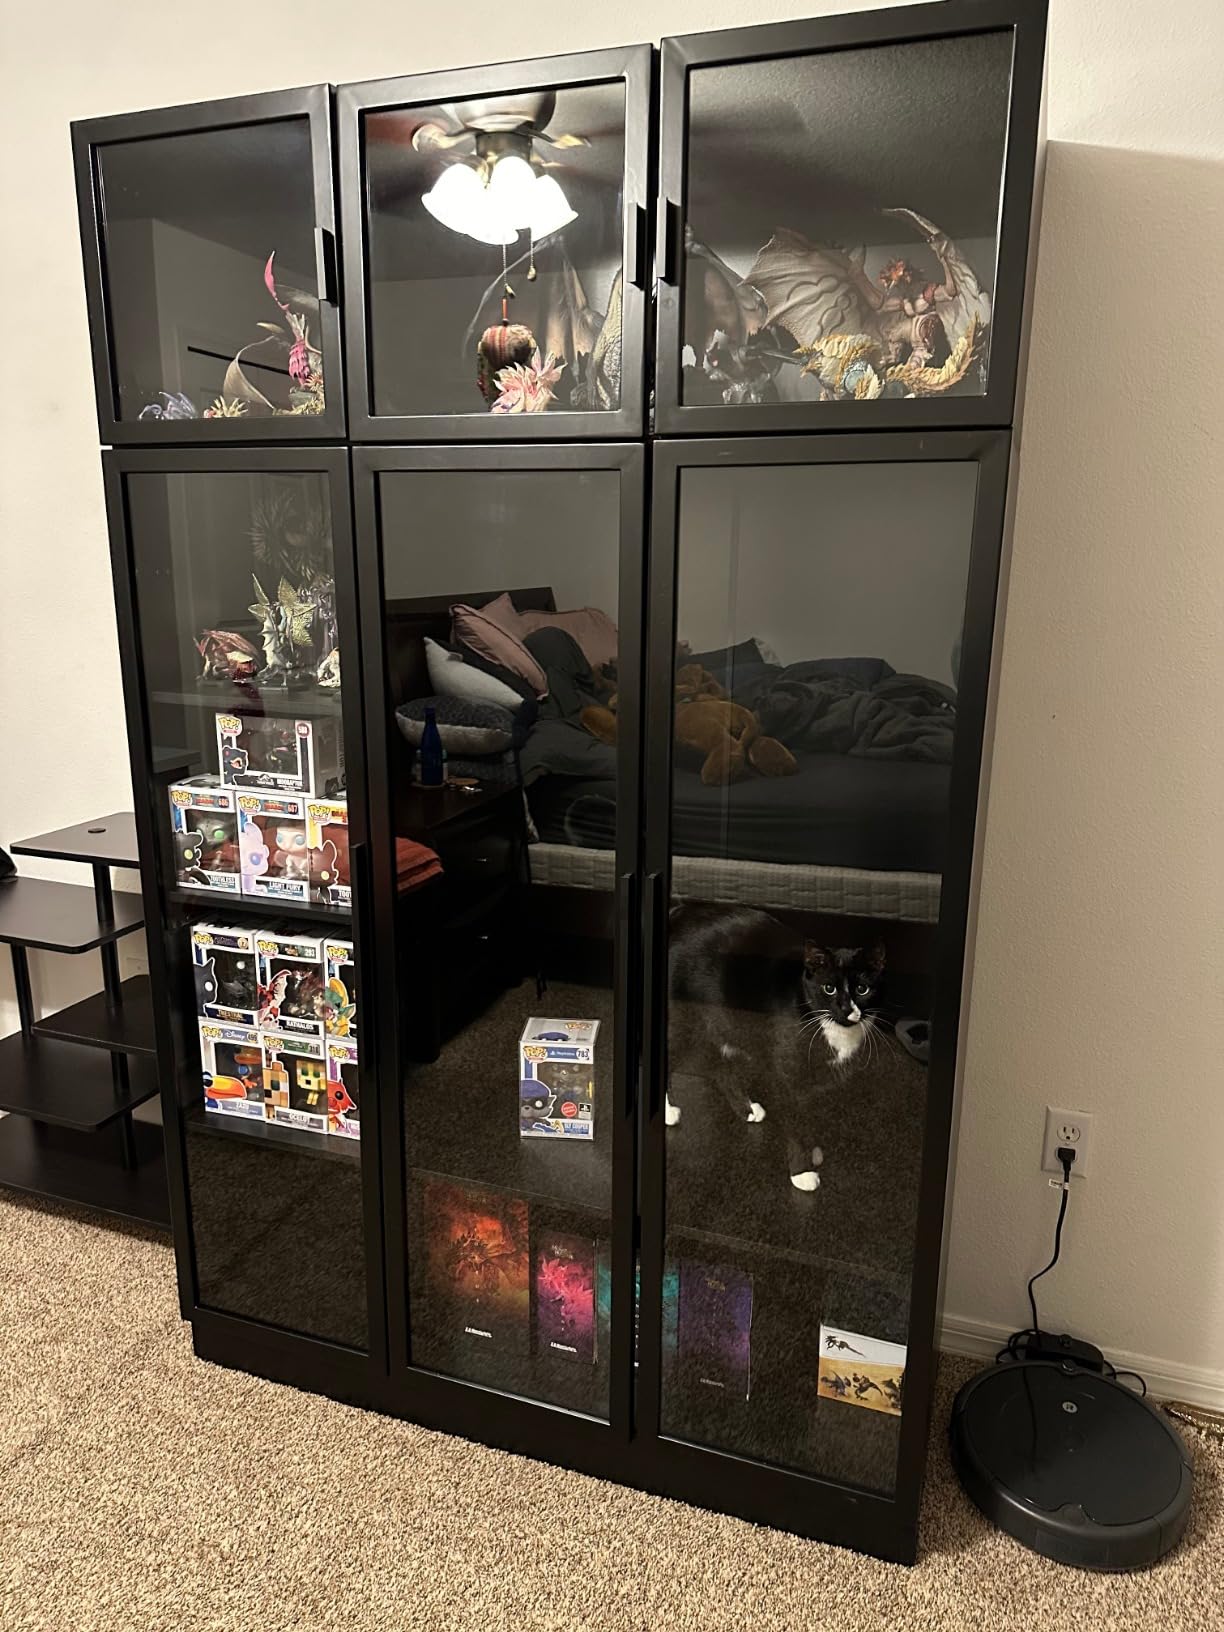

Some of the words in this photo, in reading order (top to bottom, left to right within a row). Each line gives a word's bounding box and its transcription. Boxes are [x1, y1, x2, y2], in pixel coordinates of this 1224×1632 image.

[218, 716, 240, 730] POP!
[171, 790, 192, 803] POP!
[239, 796, 259, 809] POP!
[308, 805, 331, 818] POP!
[194, 932, 214, 945] POP!
[257, 940, 279, 955] POP!
[327, 946, 348, 960] POP!
[202, 1025, 223, 1039] POP!
[264, 1037, 284, 1050] POP!
[328, 1046, 350, 1058] POP!
[524, 1045, 547, 1057] POP!
[577, 1049, 589, 1058] 783
